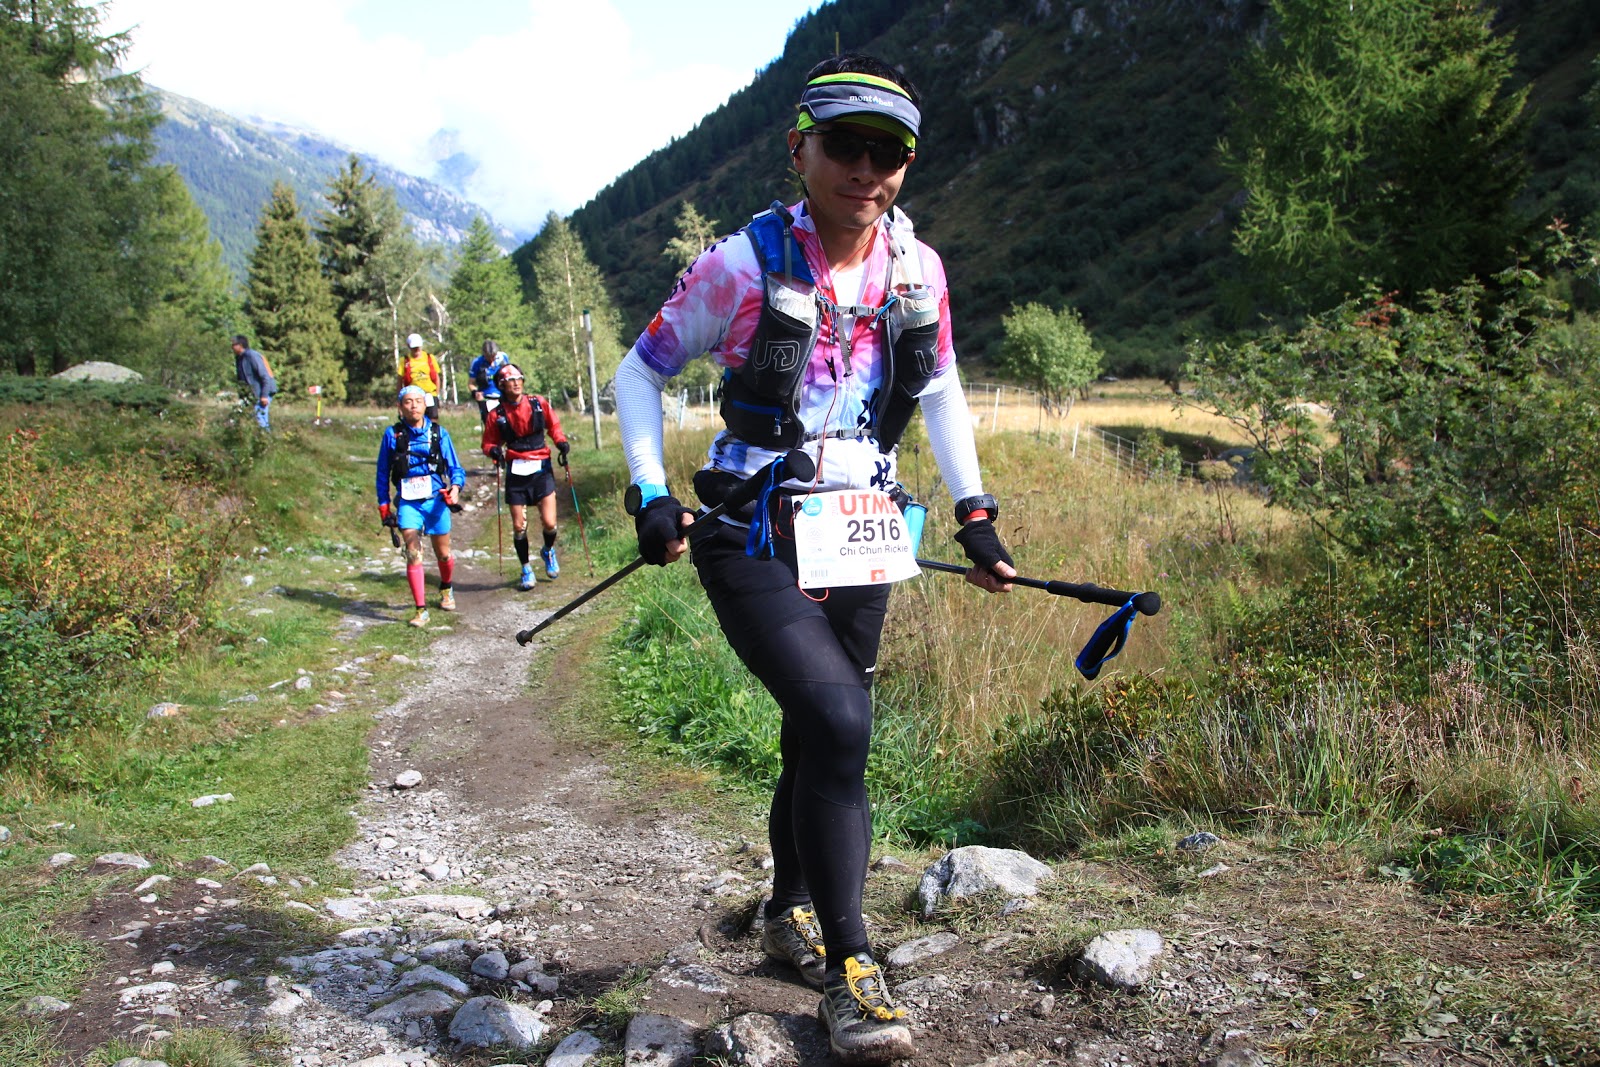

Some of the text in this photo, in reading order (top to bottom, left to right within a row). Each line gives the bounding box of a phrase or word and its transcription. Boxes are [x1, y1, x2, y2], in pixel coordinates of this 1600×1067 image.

[847, 518, 900, 542] 2516
[839, 544, 909, 556] Chi Chun Rickie
